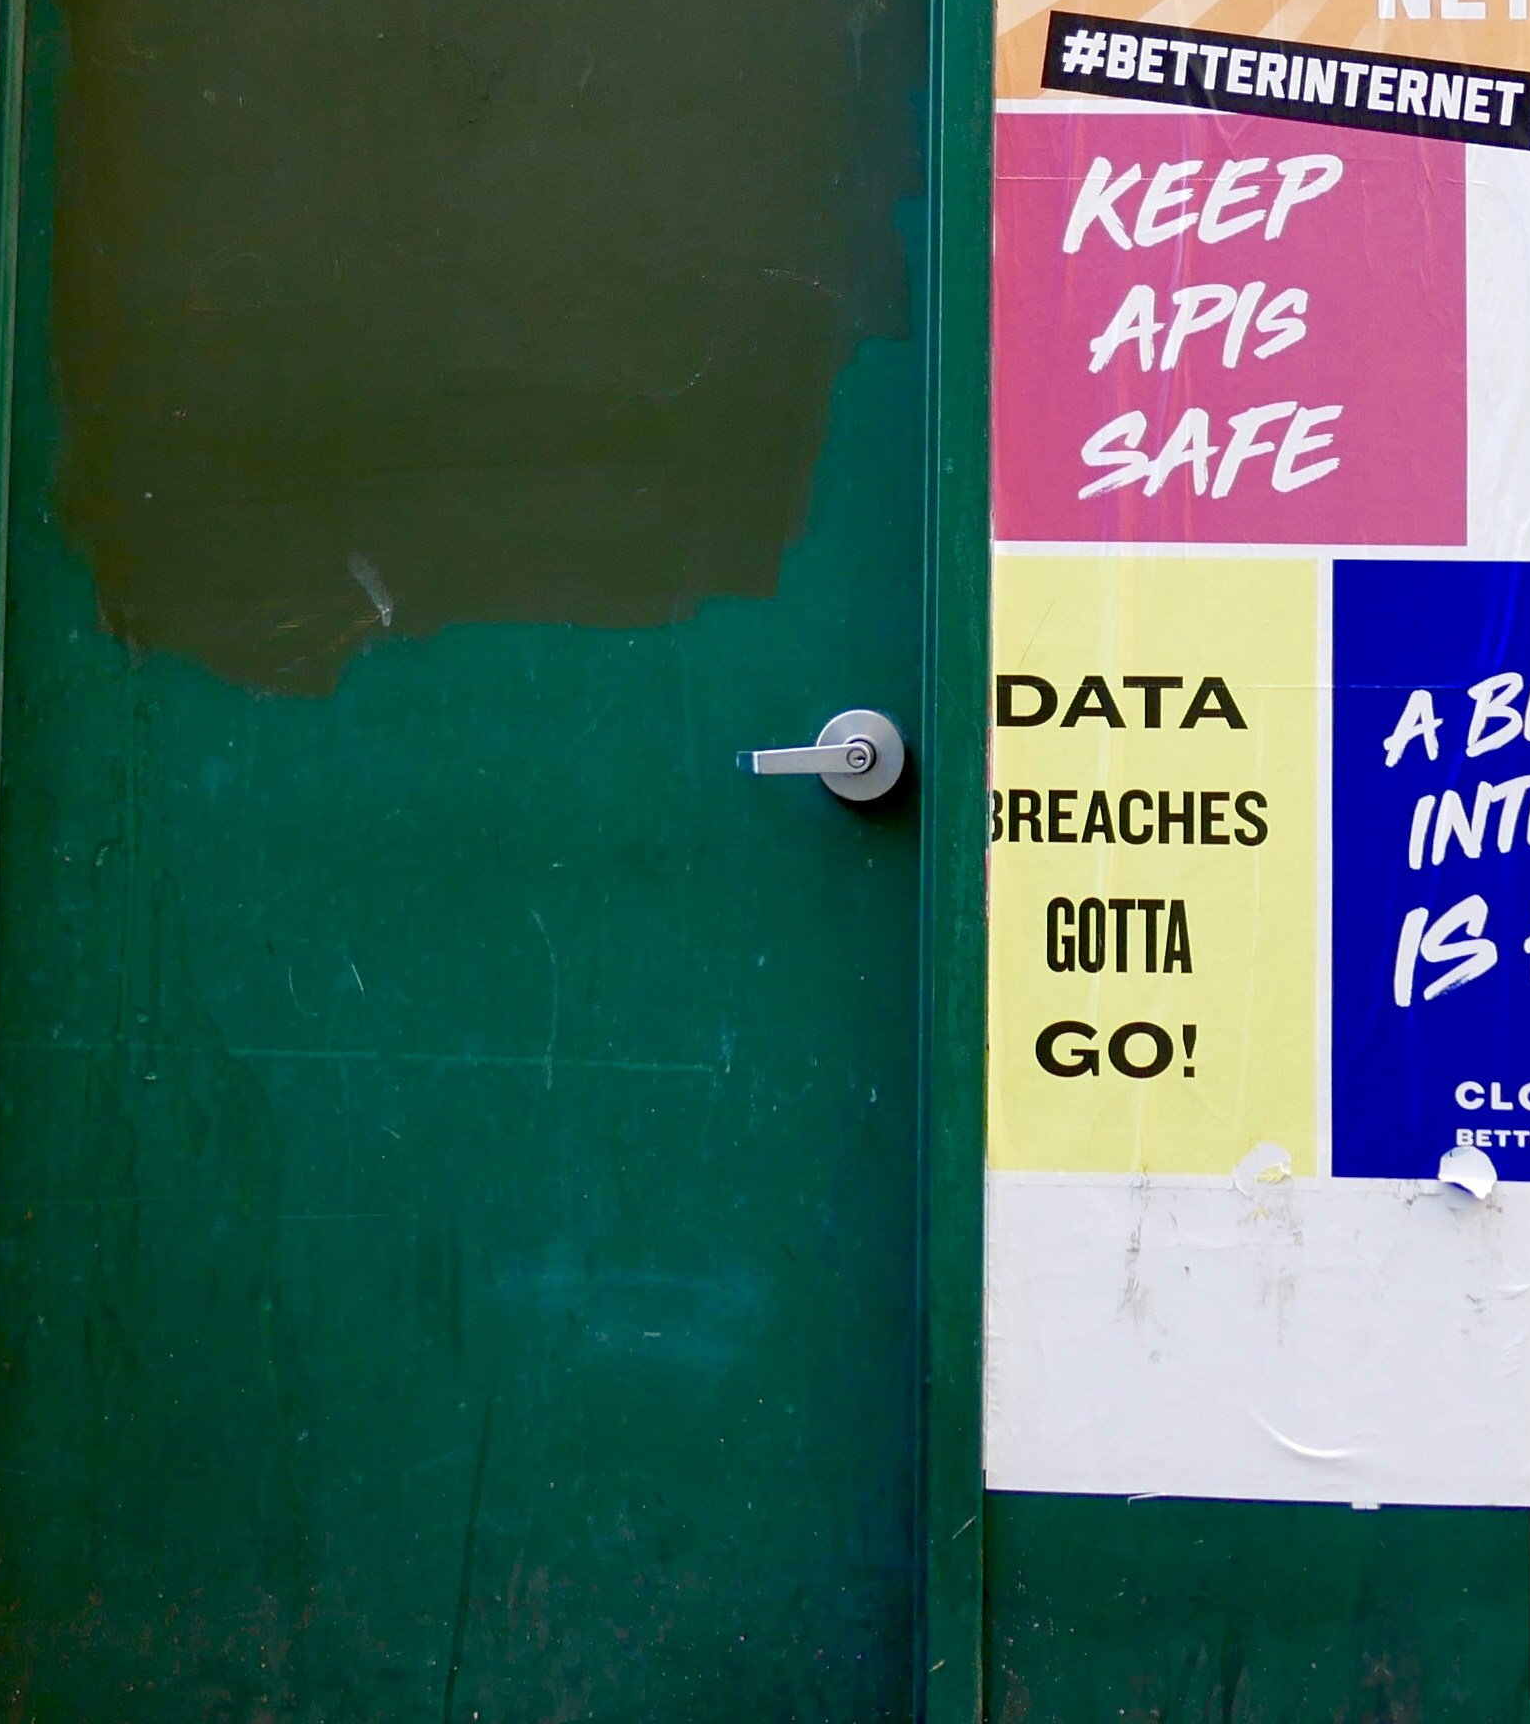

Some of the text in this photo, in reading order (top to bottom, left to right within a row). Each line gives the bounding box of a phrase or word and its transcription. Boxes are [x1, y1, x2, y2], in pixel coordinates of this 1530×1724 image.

[1062, 30, 1525, 126] #BETTERINTERNET
[1062, 153, 1344, 254] KEEP
[1078, 401, 1343, 499] SAFE
[996, 675, 1249, 729] DATA
[1383, 690, 1444, 767] A
[1046, 897, 1192, 974] GOTTA
[1394, 894, 1497, 1007] IS
[1035, 1020, 1197, 1079] GO!
